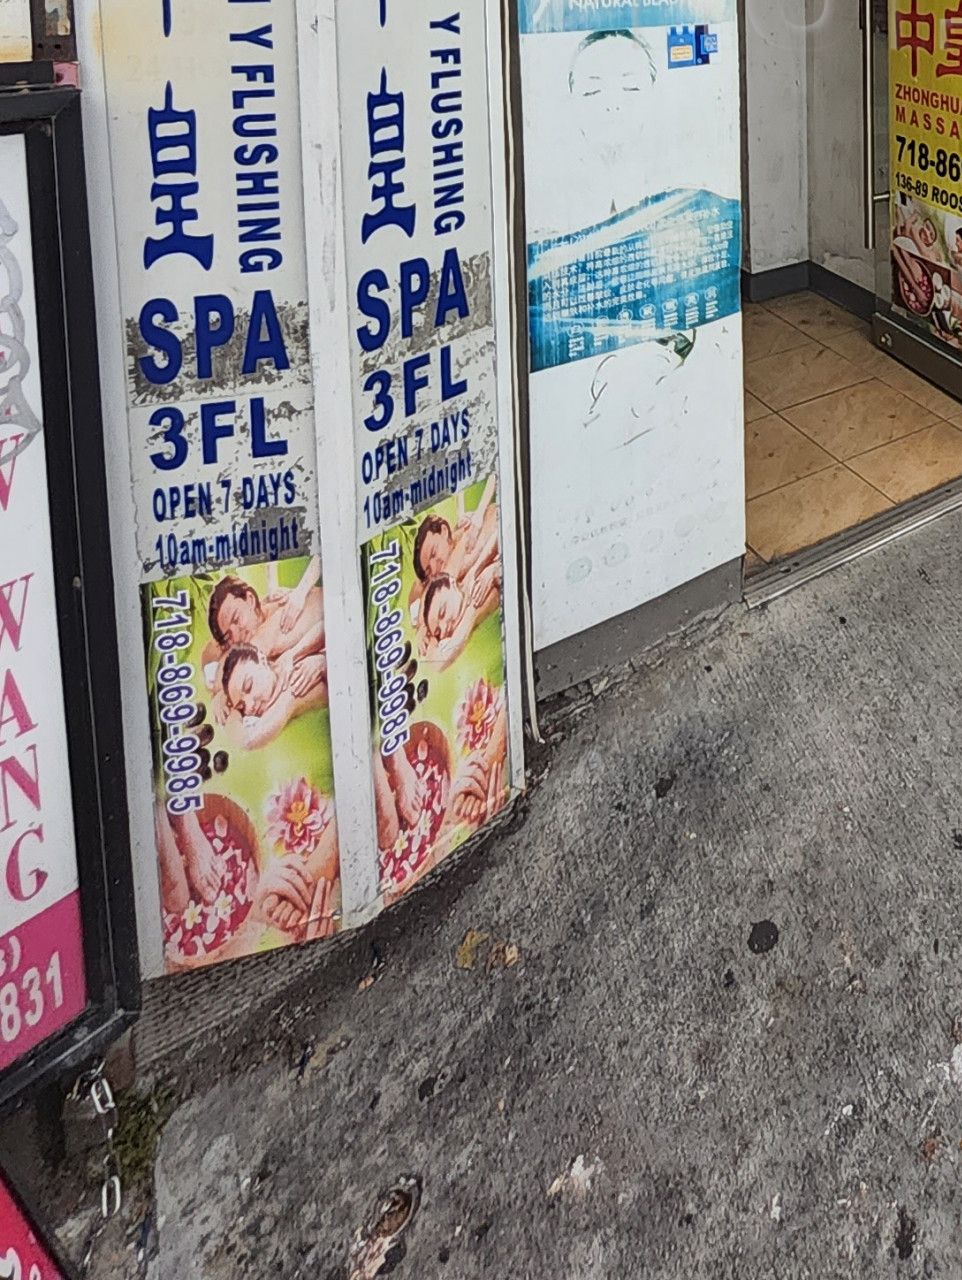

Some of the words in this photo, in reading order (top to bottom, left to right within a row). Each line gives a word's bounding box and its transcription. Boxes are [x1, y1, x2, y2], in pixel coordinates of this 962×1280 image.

[230, 64, 284, 274] FLUSHING
[429, 47, 466, 237] FLUSHING
[894, 171, 929, 199] 136-89
[138, 289, 290, 386] SPA
[355, 246, 470, 353] SPA
[362, 345, 468, 433] 3FL
[147, 396, 289, 471] 3FL
[361, 438, 409, 486] OPEN
[414, 429, 424, 463] 7
[430, 407, 471, 455] DAYS
[152, 480, 213, 523] OPEN
[221, 479, 231, 514] 7
[242, 471, 297, 511] DAYS
[363, 450, 473, 530] 10am-midnight
[154, 518, 299, 570] 10am-midnight
[368, 539, 411, 756] 718-869-9985
[153, 591, 204, 816] 718-869-9985
